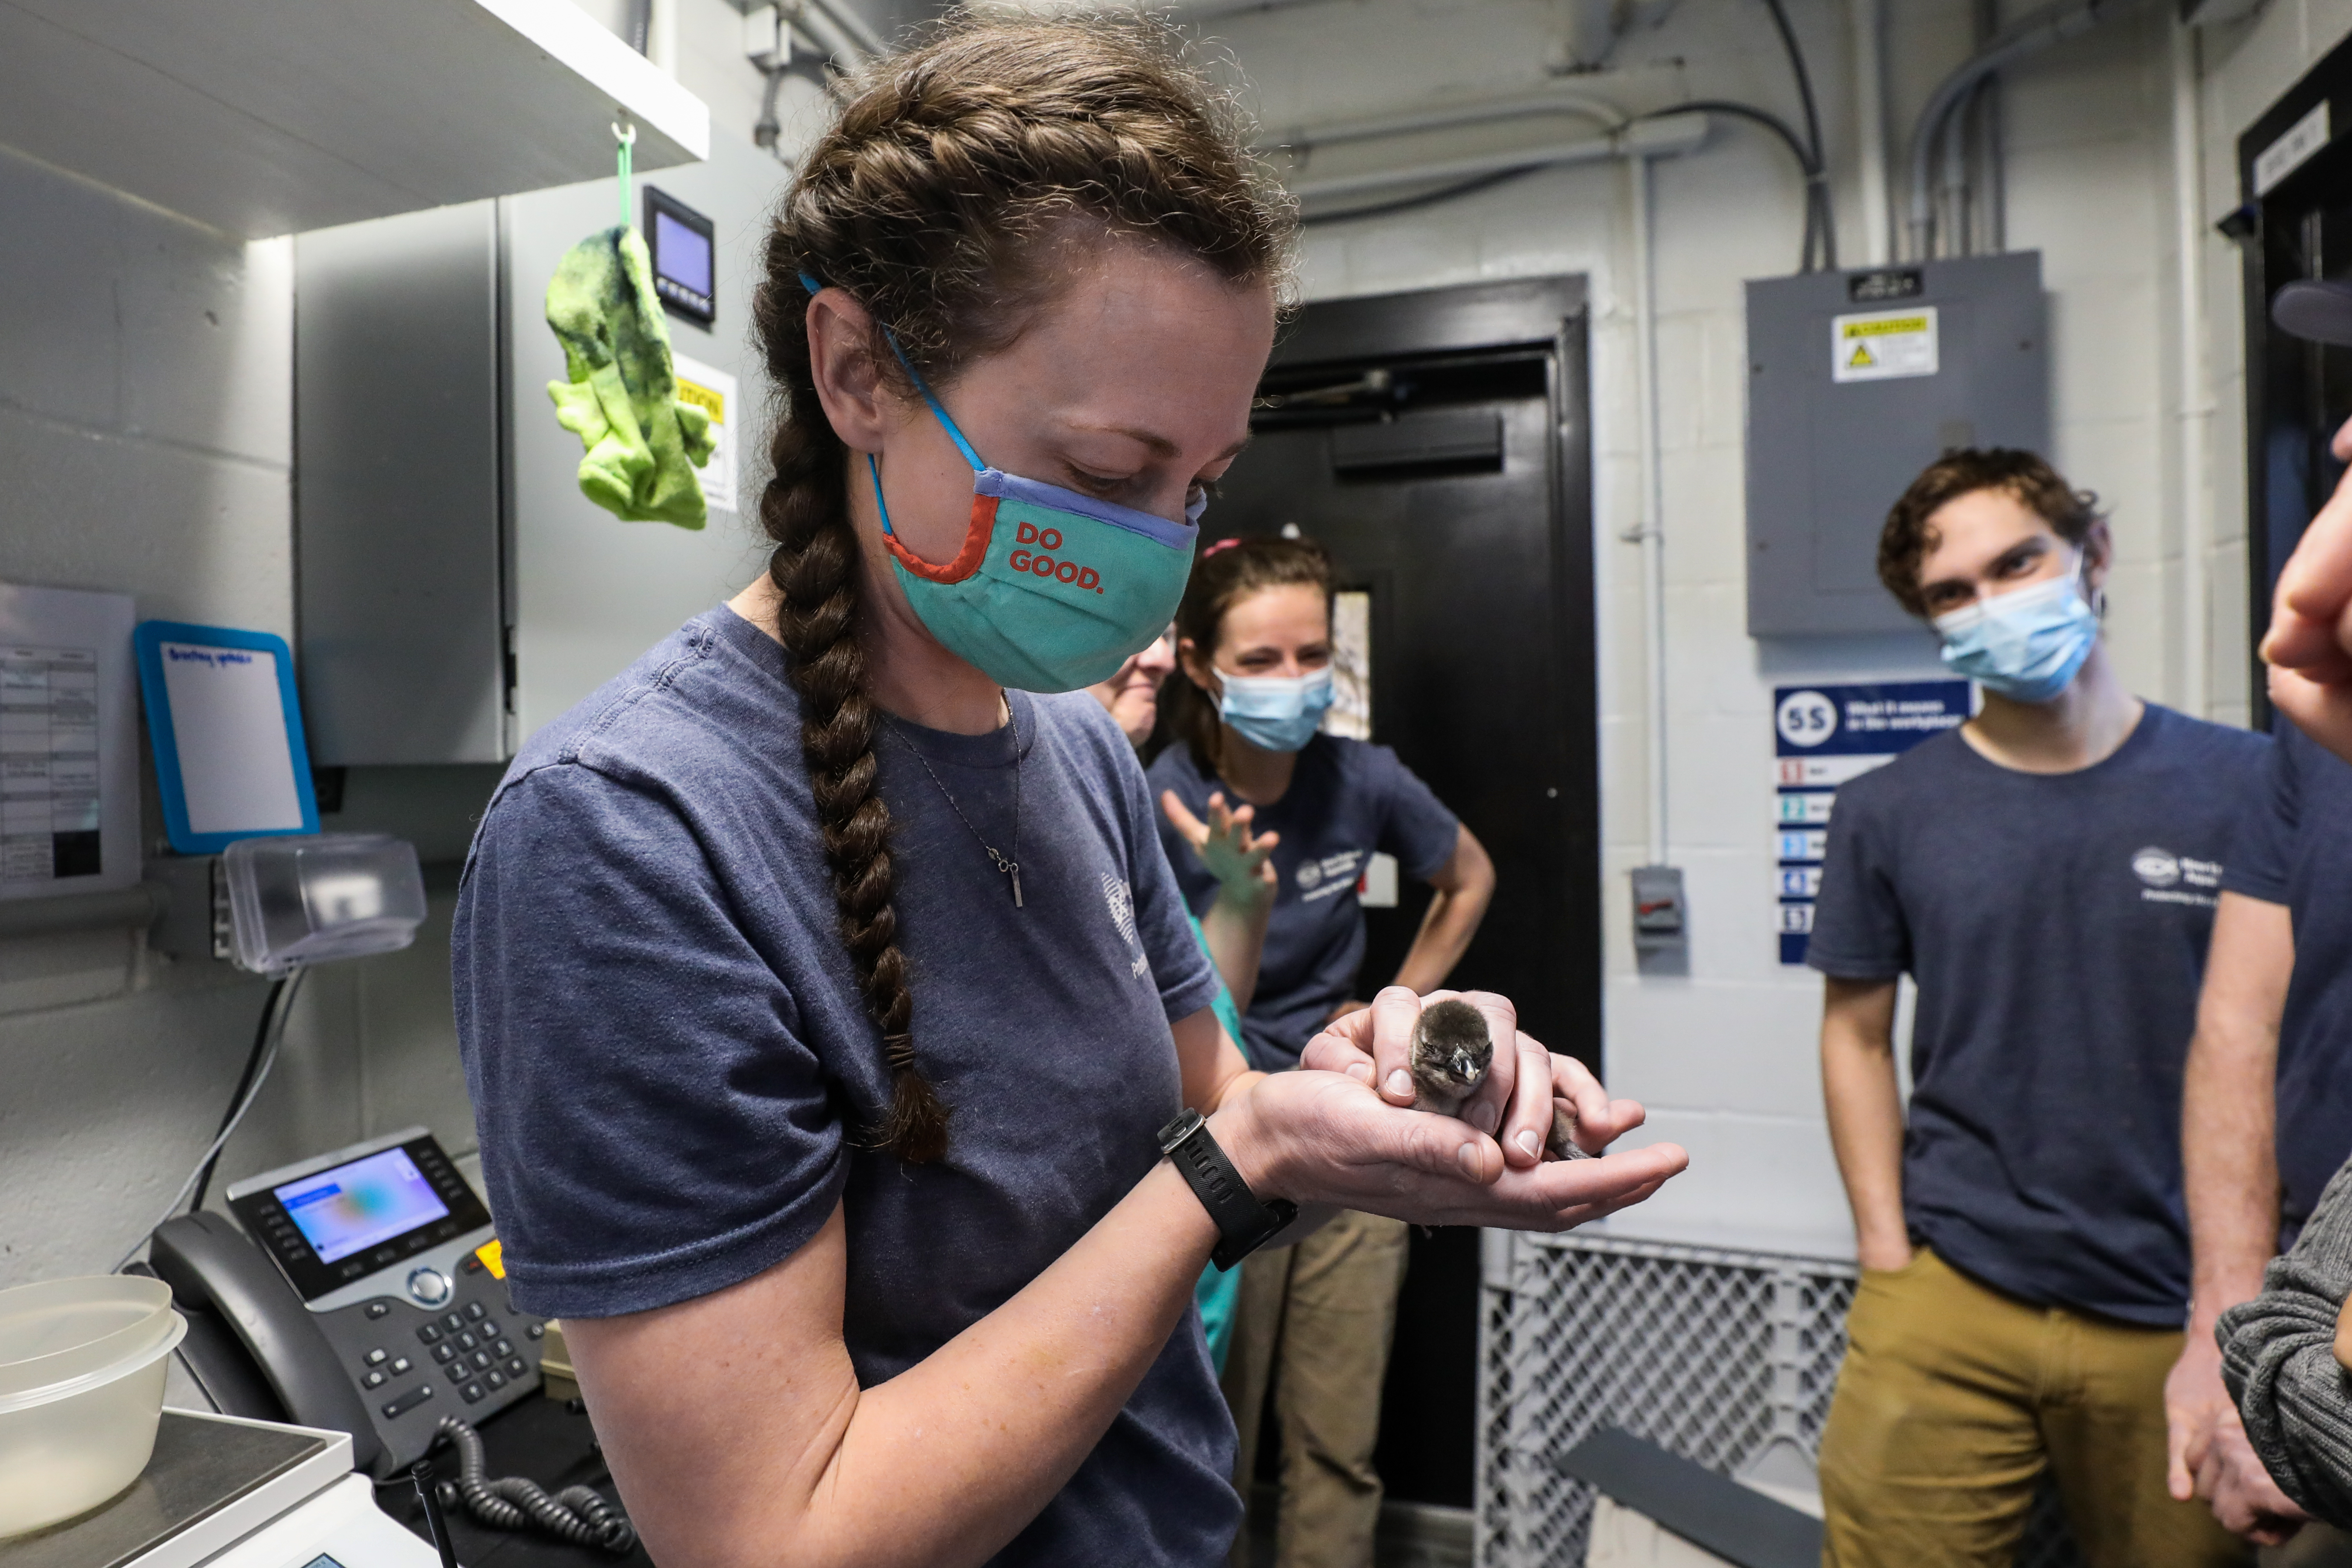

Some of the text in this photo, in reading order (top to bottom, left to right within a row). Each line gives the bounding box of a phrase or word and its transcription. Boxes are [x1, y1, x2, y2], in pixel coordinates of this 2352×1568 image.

[1016, 522, 1063, 550] DO
[1010, 549, 1104, 594] GOOD.
[1788, 706, 1826, 730] 5S
